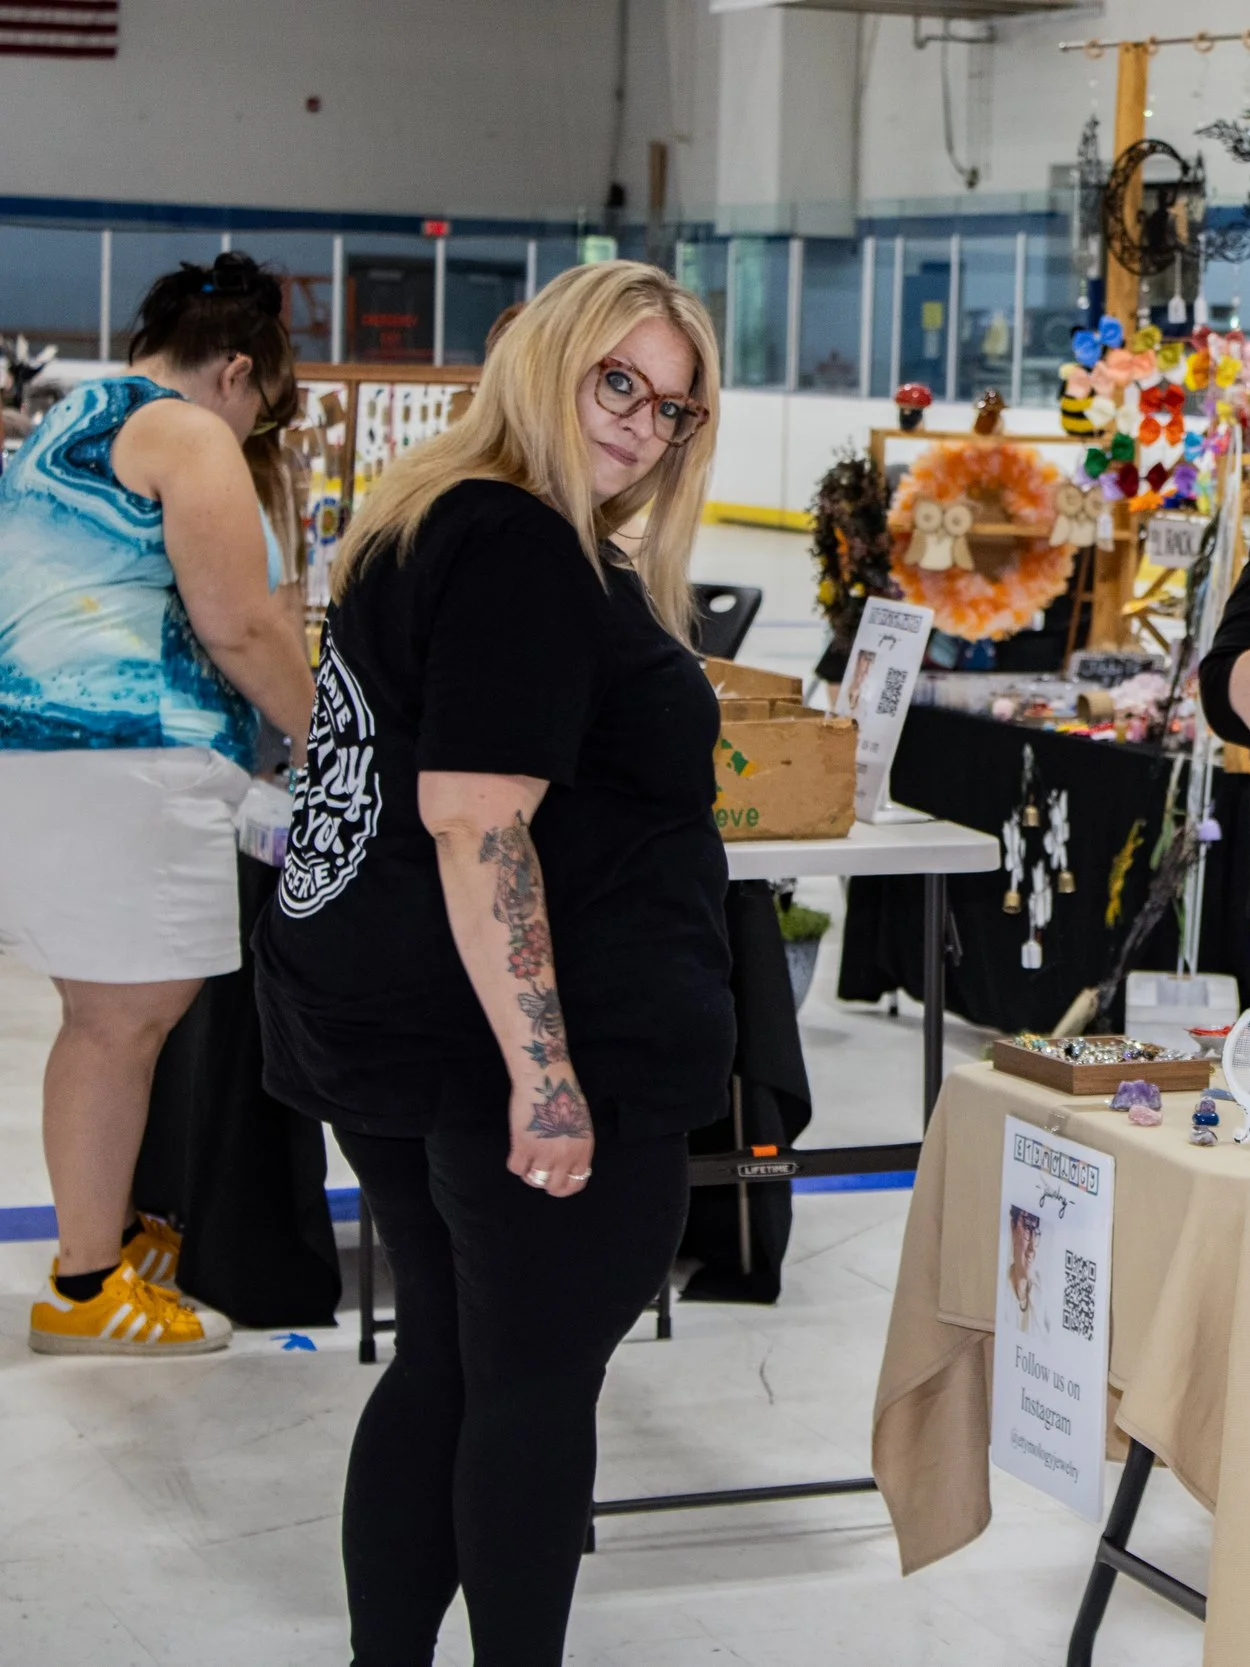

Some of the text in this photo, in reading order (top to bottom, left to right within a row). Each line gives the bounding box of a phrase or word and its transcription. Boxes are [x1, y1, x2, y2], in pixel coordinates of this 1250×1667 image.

[1015, 1344, 1081, 1401] Follow us on
[1020, 1386, 1072, 1436] Instagram
